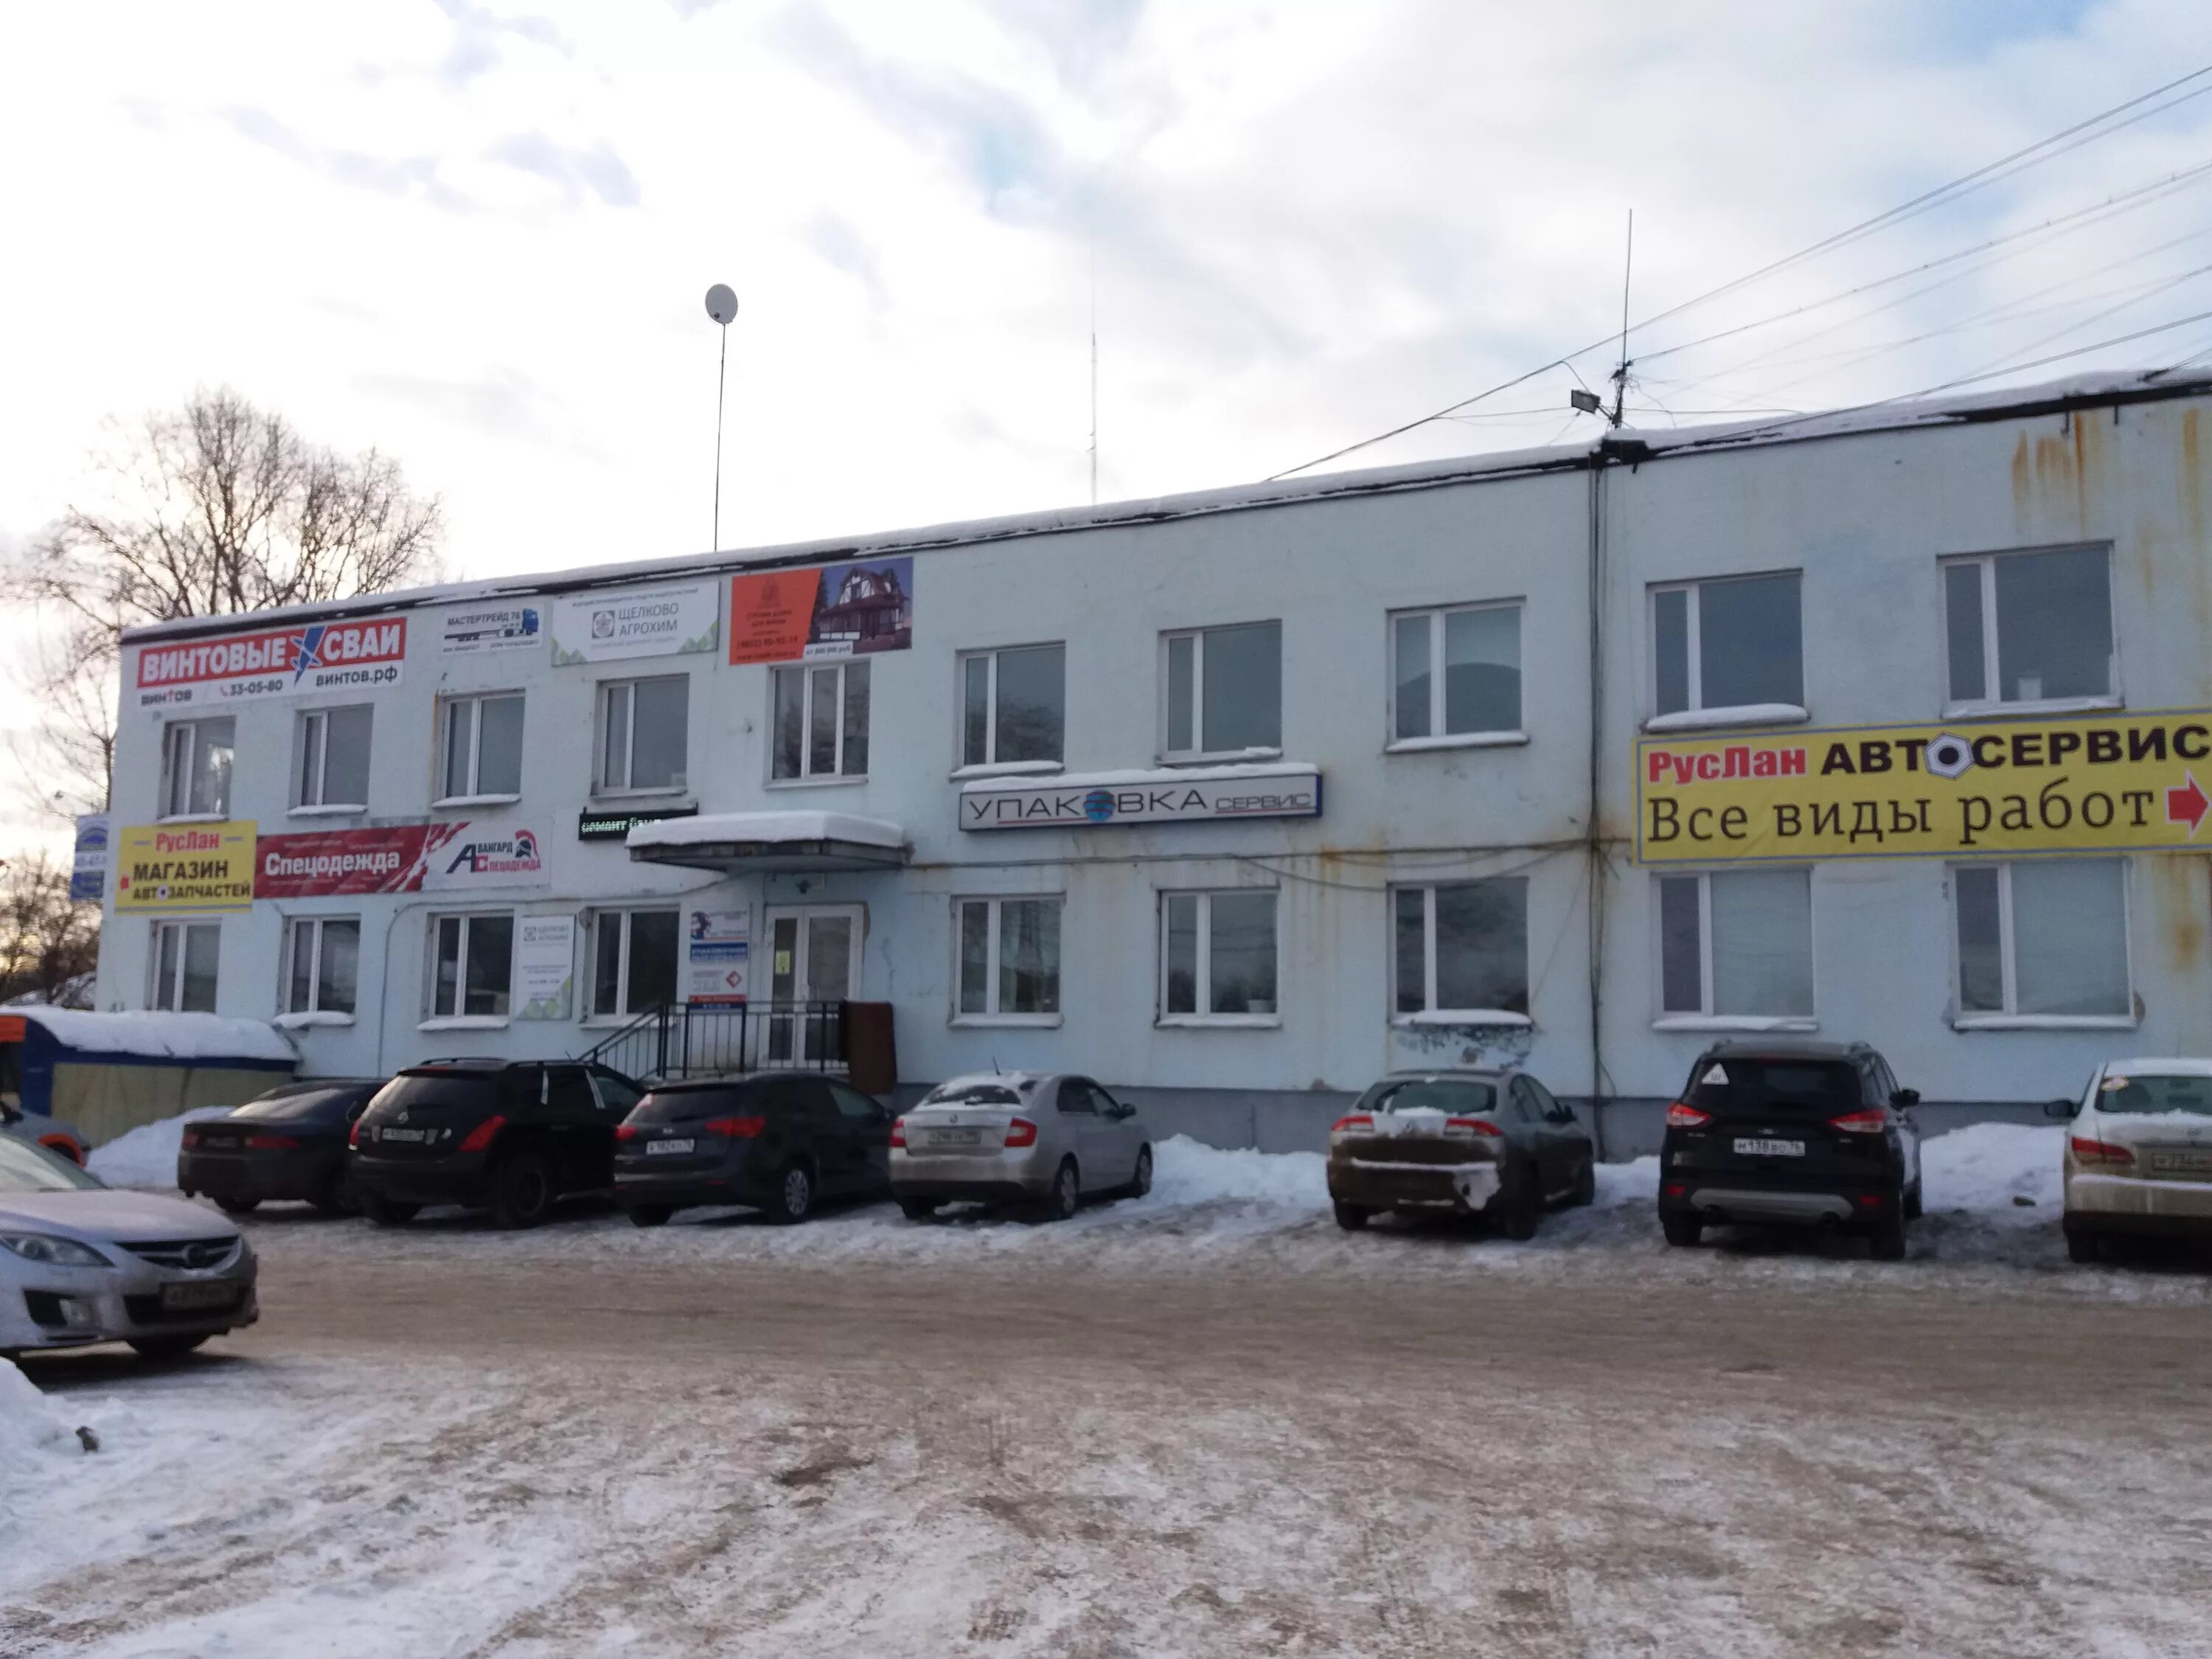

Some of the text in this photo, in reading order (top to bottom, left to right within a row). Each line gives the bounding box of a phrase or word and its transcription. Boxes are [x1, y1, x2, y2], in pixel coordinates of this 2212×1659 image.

[618, 602, 679, 621] ЩЕЛКОВО
[619, 619, 678, 636] АГРОХИМ
[142, 624, 401, 682] ВИНТОВЫЕ СВАИ
[229, 679, 284, 697] 33-05-80
[1215, 793, 1312, 811] СЕРВИС
[1646, 777, 2156, 846] Все виды работ
[133, 860, 229, 882] МАГАЗИН
[265, 851, 401, 878] Спецодежда
